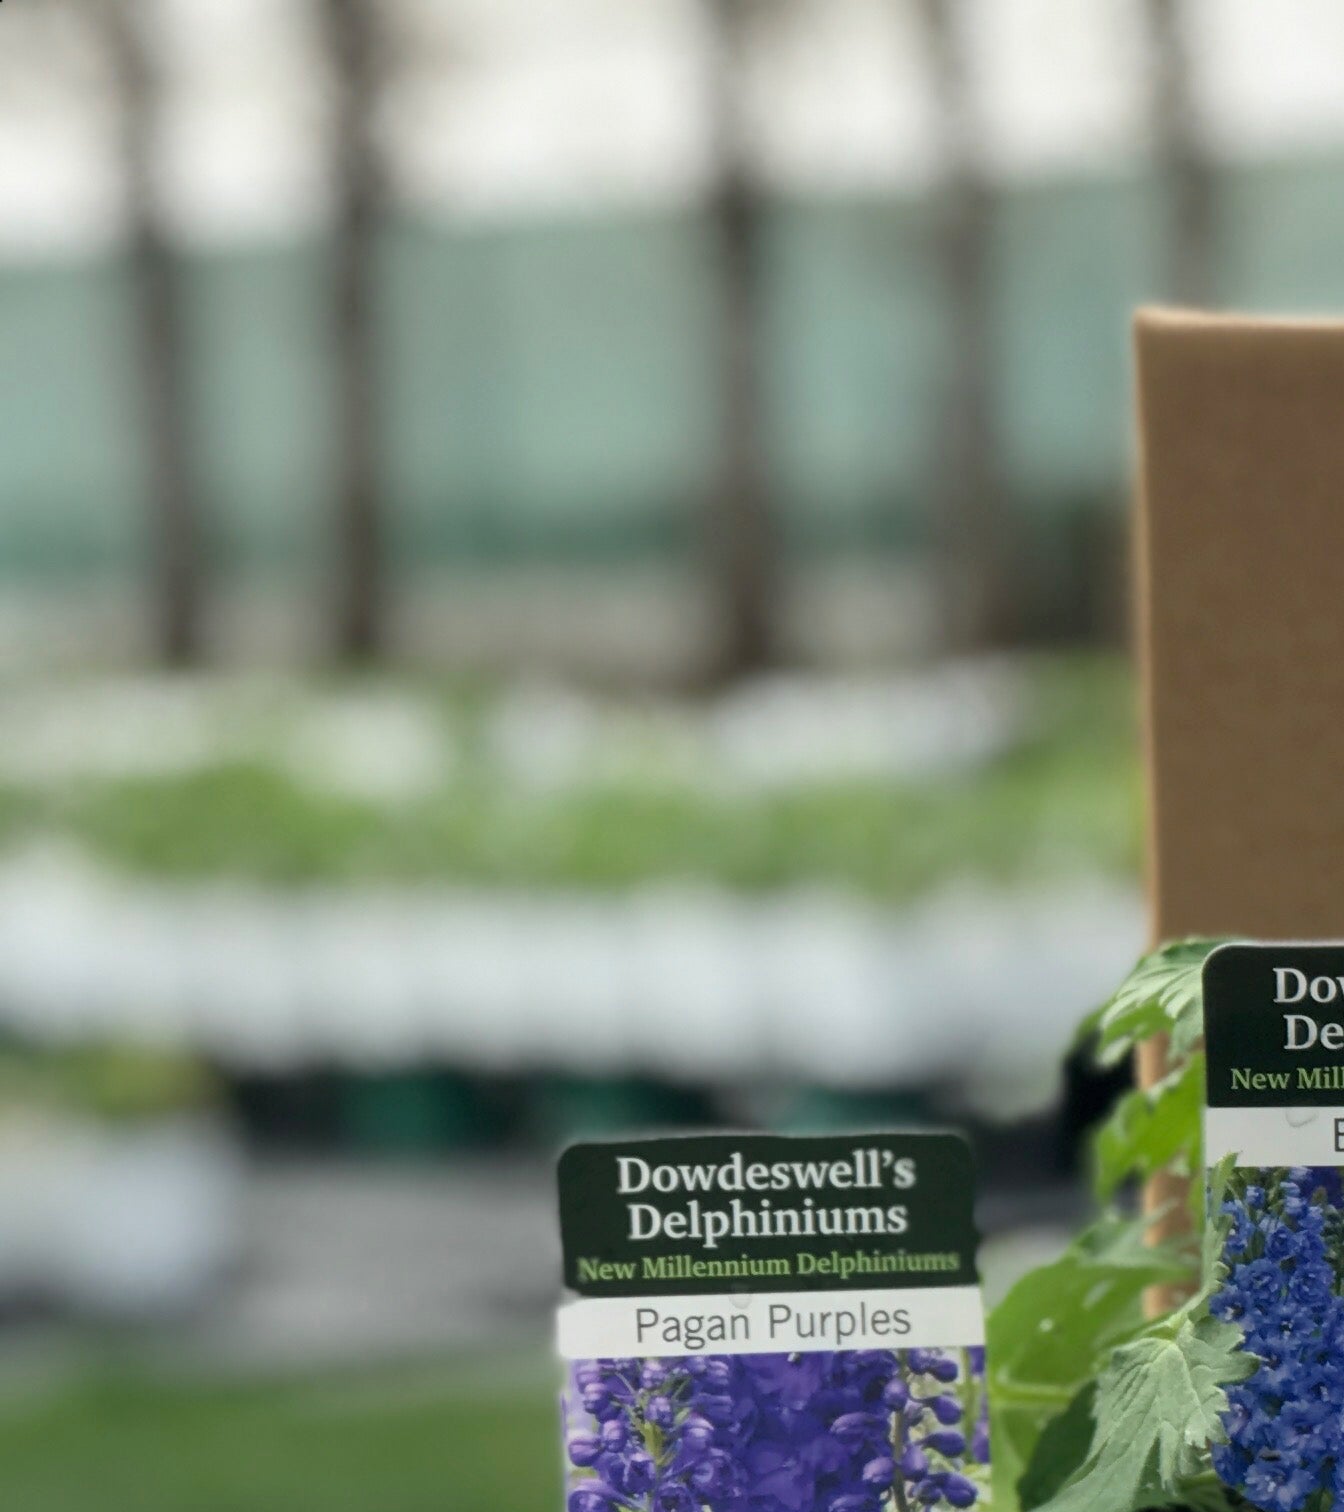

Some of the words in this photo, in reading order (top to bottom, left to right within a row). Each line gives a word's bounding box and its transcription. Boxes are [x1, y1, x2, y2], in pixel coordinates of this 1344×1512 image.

[1231, 1068, 1290, 1090] New
[616, 1148, 917, 1195] Dowdeswell's
[627, 1198, 909, 1249] Delphiniums
[577, 1256, 637, 1283] New
[642, 1253, 791, 1280] Millennium
[797, 1249, 960, 1280] Delphiniums
[635, 1307, 751, 1350] Pagan
[768, 1301, 912, 1345] Purples
